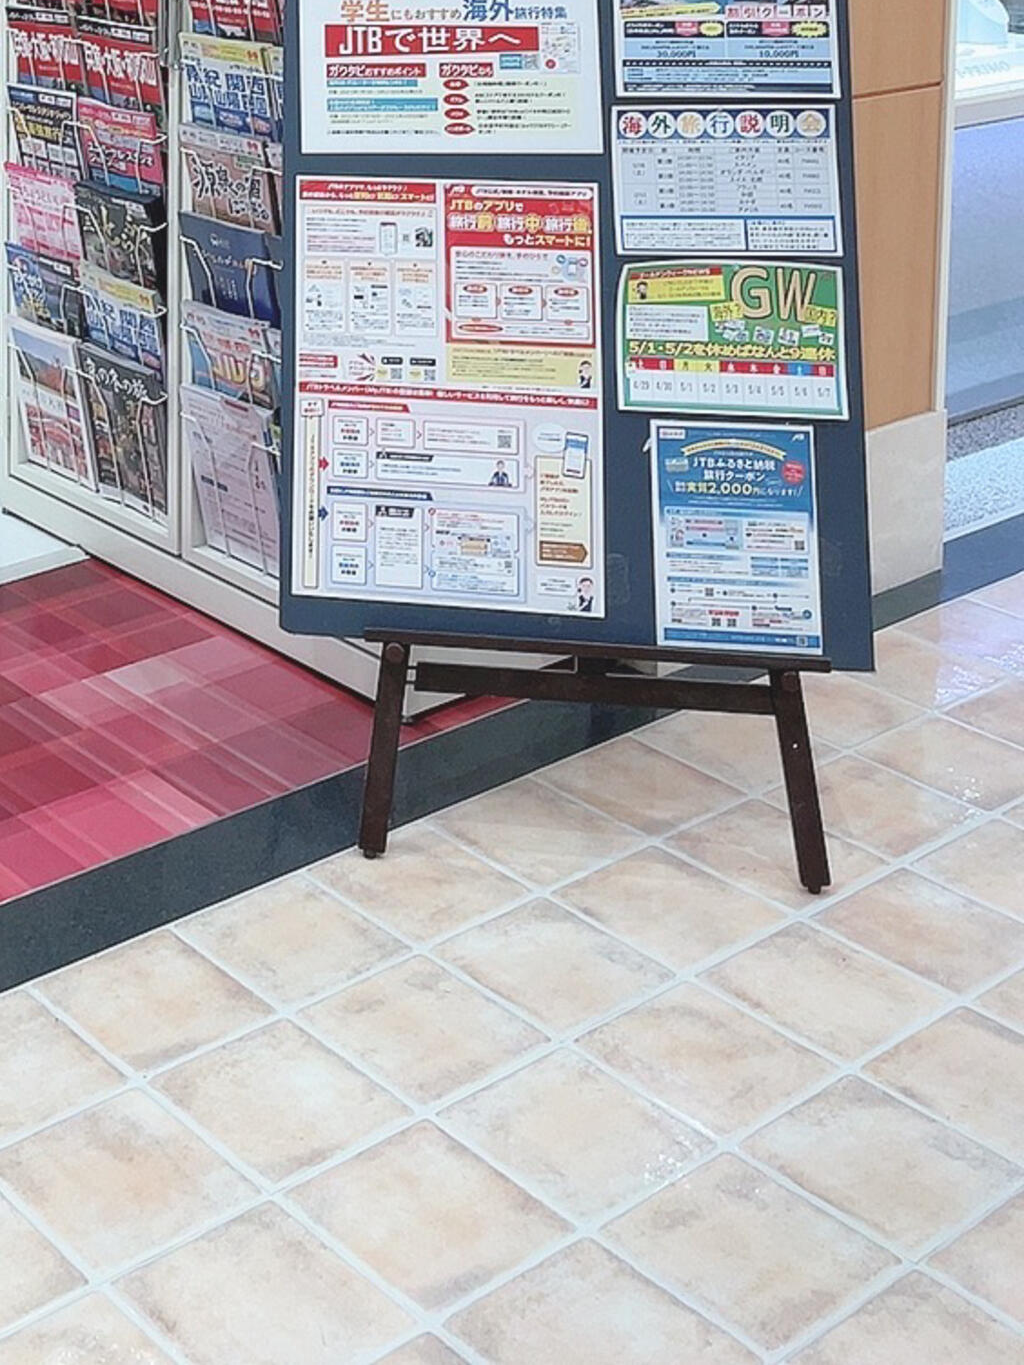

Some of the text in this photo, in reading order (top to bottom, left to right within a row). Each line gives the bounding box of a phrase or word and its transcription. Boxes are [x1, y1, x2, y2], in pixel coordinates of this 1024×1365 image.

[339, 26, 521, 55] JTBで世界へ
[622, 113, 822, 135] 海外旅行説明会
[449, 199, 523, 211] JTBのアプリで
[503, 234, 591, 246] もっとスマートに!
[730, 267, 816, 322] GW
